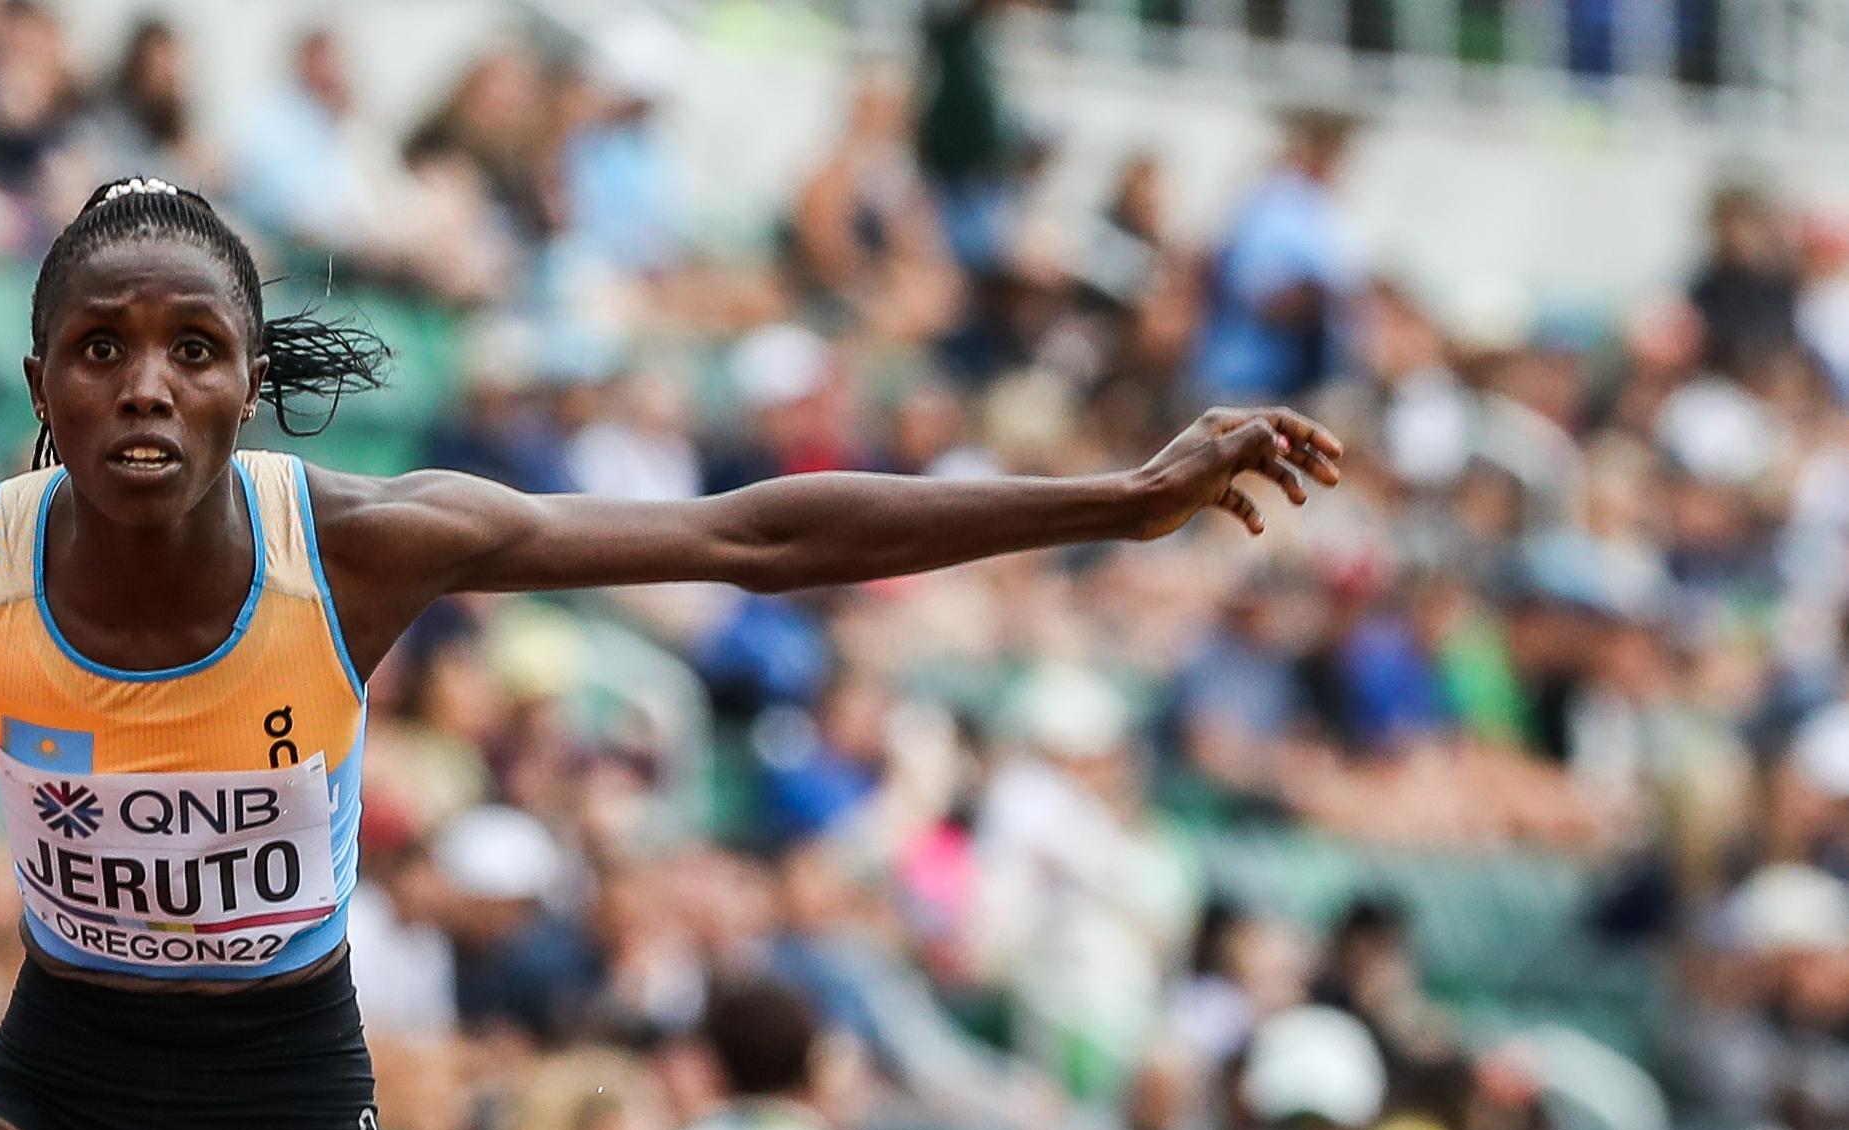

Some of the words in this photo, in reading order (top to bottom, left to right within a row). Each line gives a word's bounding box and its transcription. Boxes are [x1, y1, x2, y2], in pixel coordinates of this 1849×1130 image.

[120, 786, 281, 834] QNB
[26, 838, 301, 917] JERUTO
[56, 912, 283, 962] OREGON22
